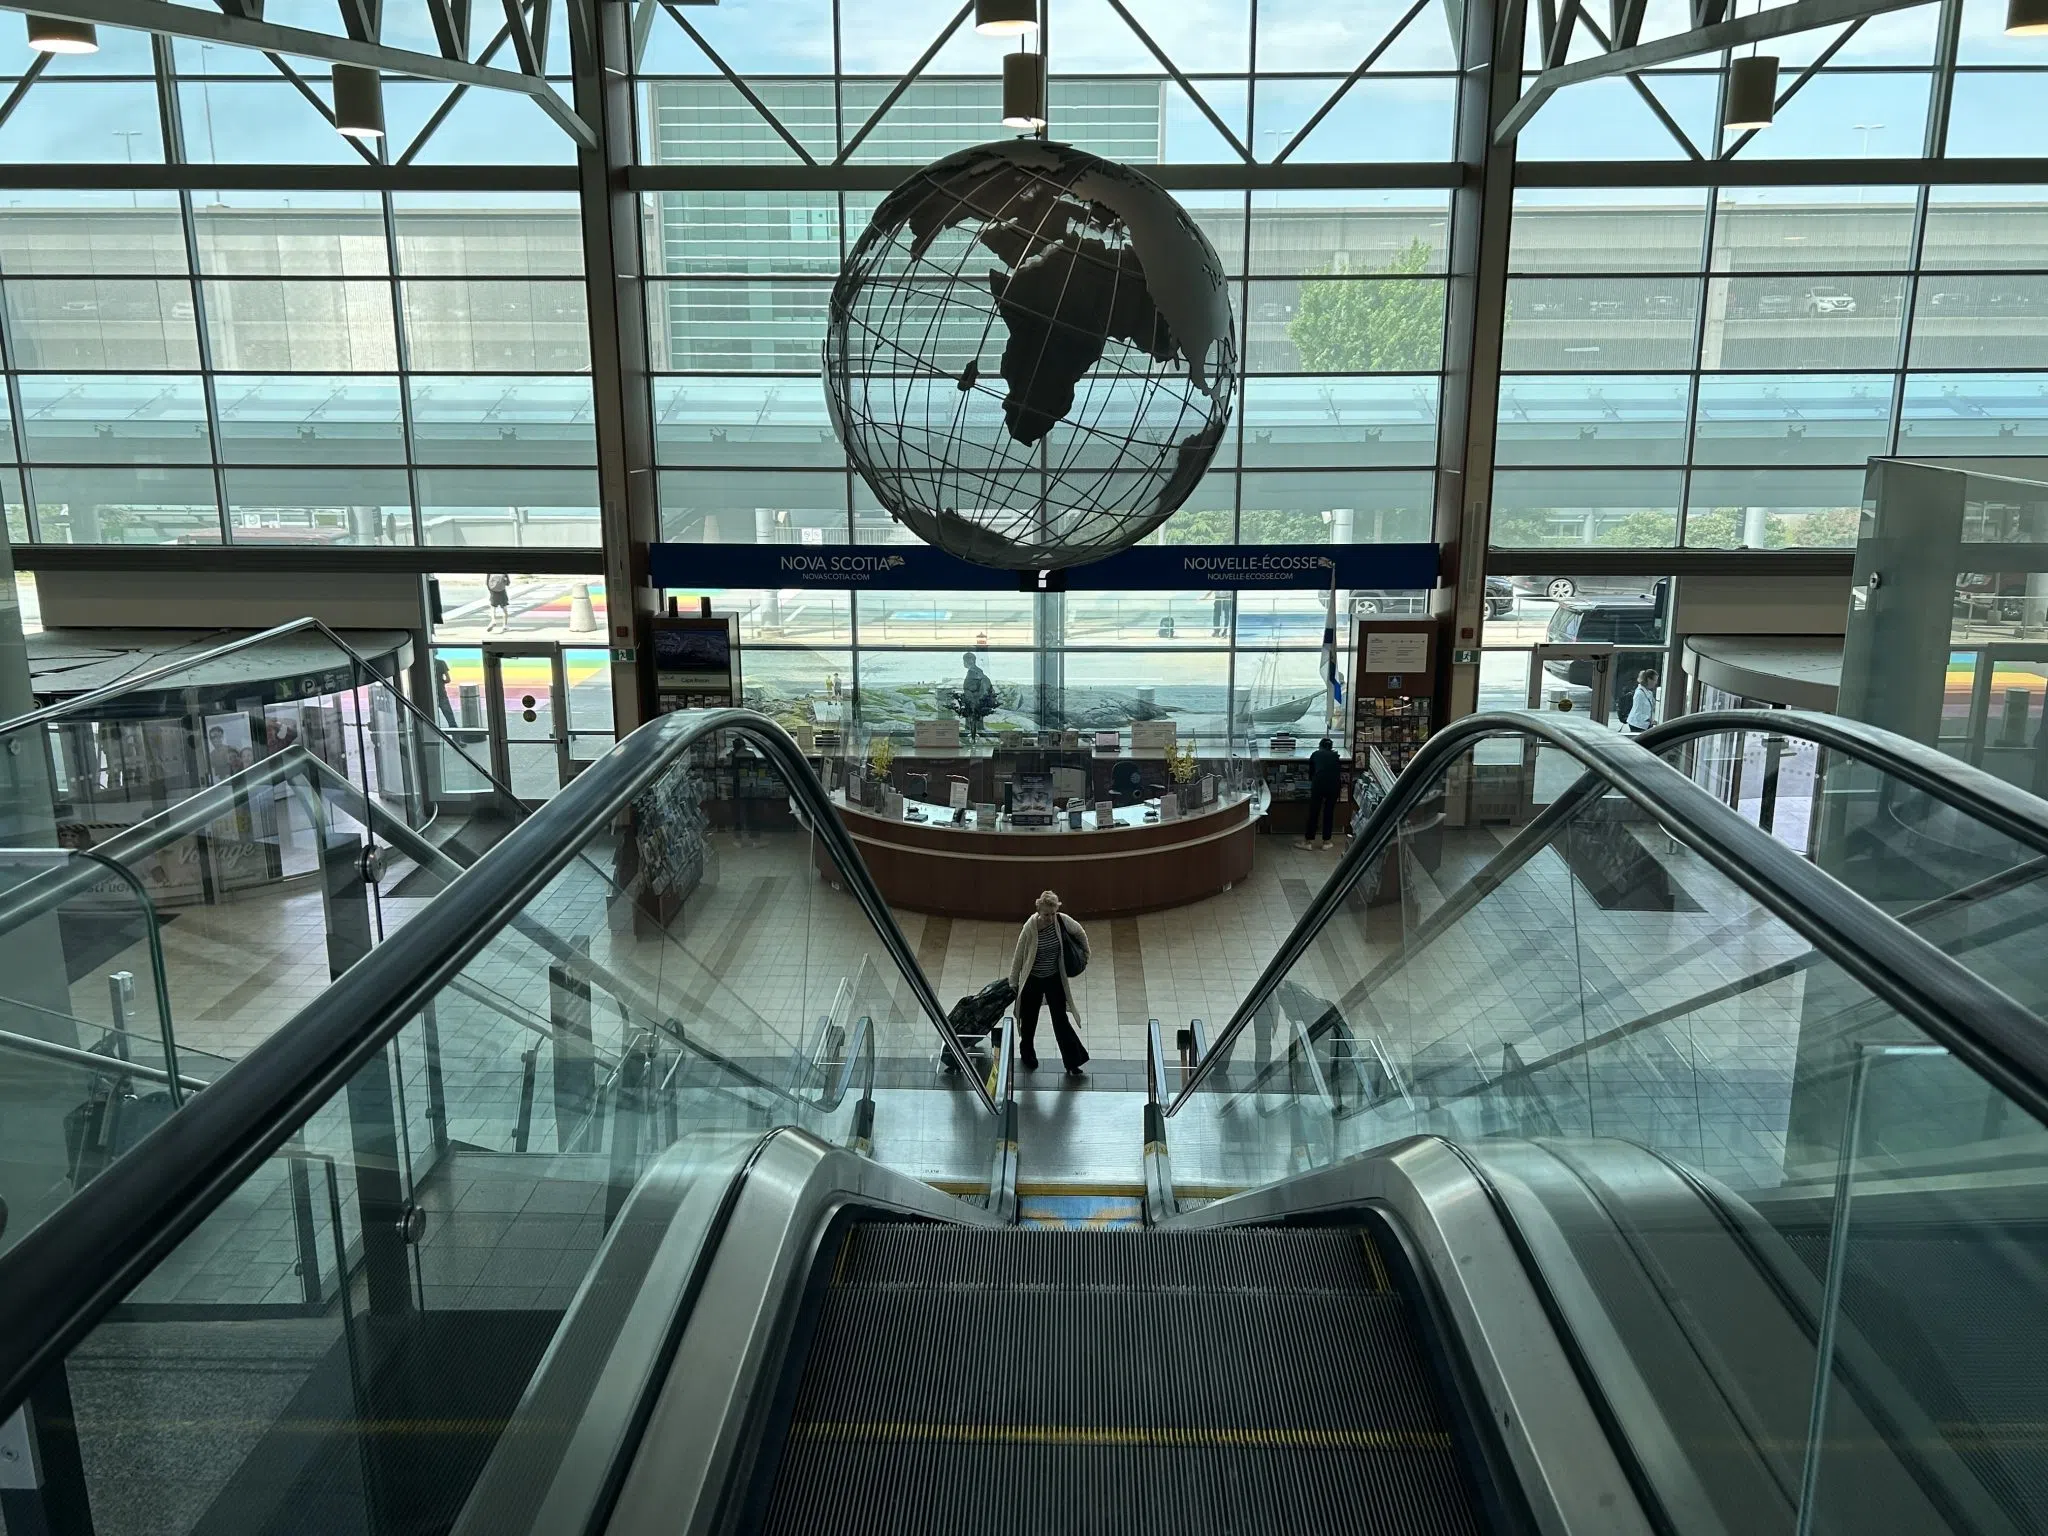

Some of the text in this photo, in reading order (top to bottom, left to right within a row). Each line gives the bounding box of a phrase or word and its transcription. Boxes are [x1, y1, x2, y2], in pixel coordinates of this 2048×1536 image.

[780, 556, 890, 571] NOVA SCOTIA
[1184, 554, 1318, 570] NOUVELLE-ÉCOSSE
[802, 573, 870, 581] NOVASCOTIA.COM
[1207, 572, 1294, 580] NOUVELLE-ECOSSE.COM
[178, 842, 255, 869] Voage
